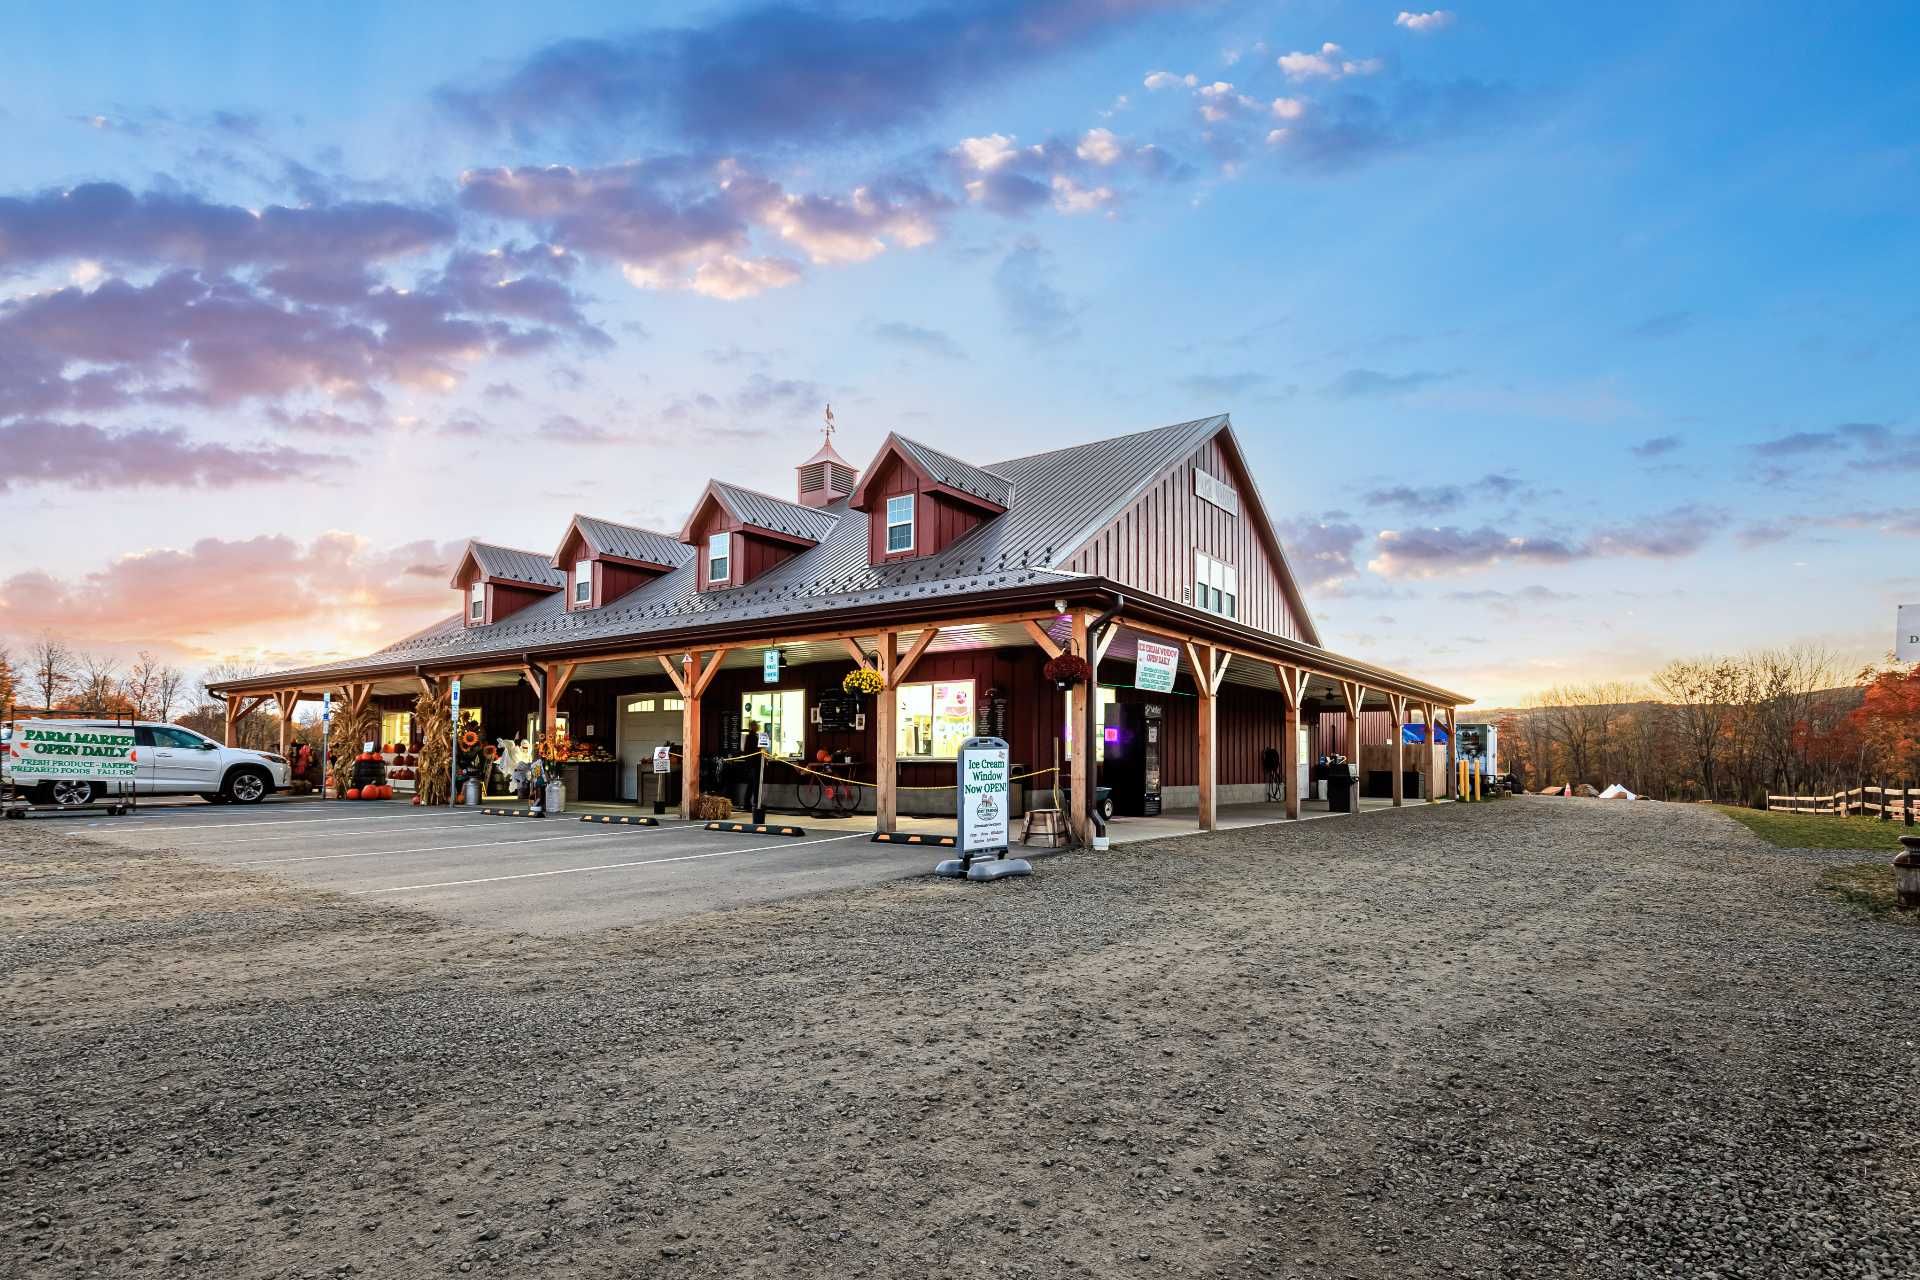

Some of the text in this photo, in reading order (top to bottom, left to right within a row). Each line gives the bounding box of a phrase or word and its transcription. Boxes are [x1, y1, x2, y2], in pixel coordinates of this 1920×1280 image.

[24, 729, 136, 746] FARM MARKET
[34, 742, 130, 758] OPEN DAILY
[21, 758, 50, 767] FRESH
[52, 760, 94, 768] PRODUCE
[968, 759, 1005, 770] Ice Cream
[10, 765, 59, 774] PREPARED
[972, 770, 1003, 781] Window
[965, 782, 1007, 794] Now OPEN!
